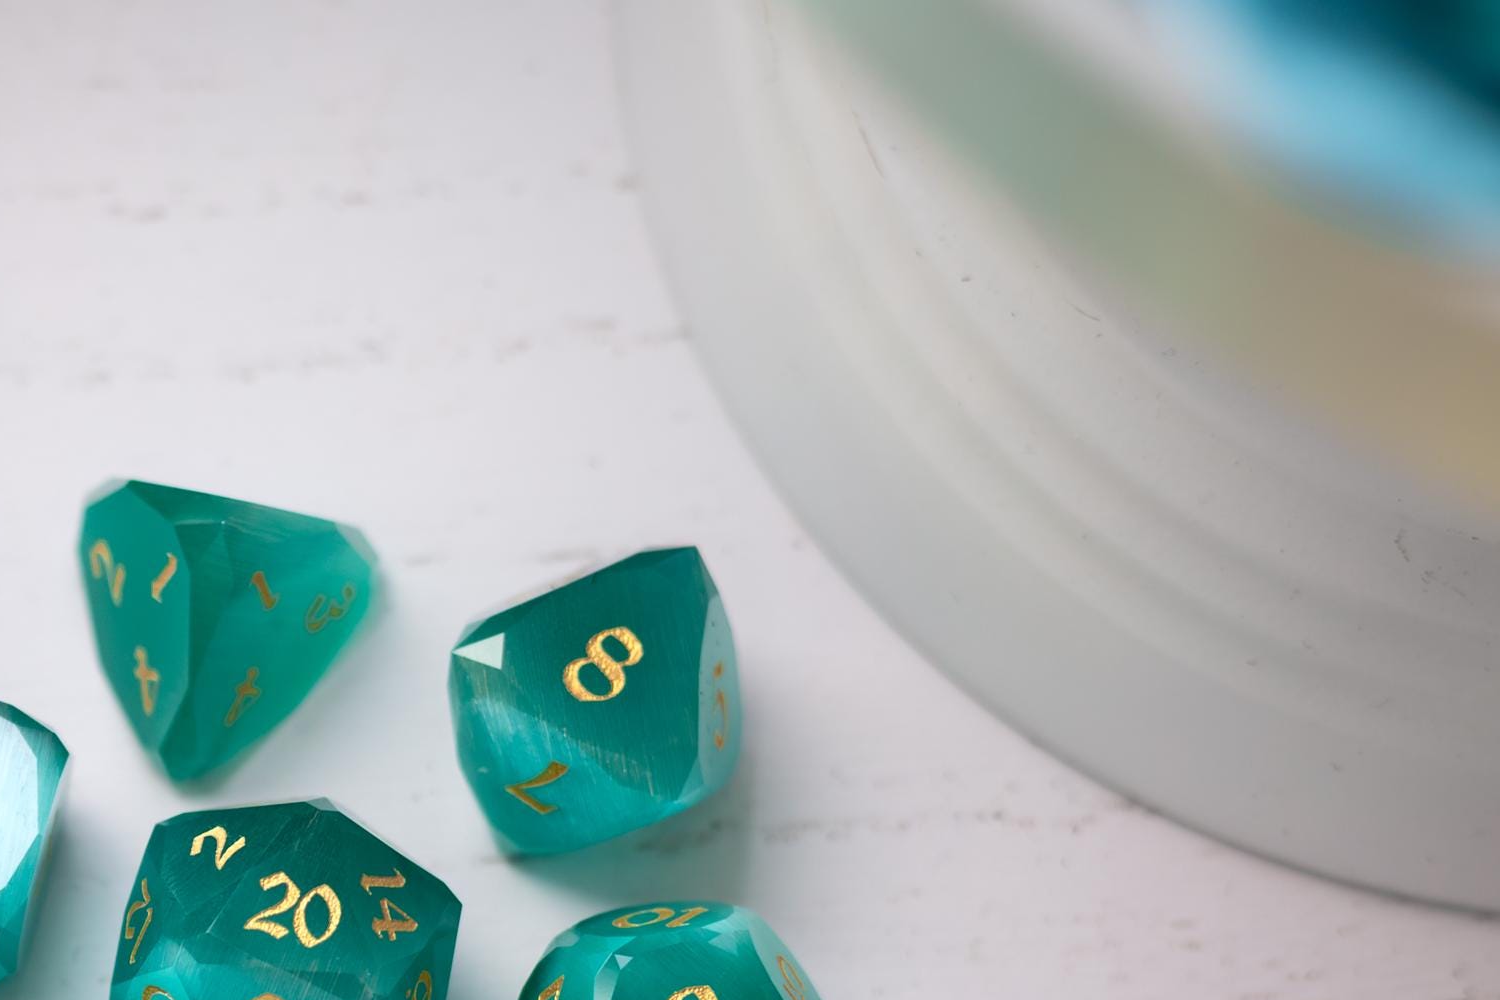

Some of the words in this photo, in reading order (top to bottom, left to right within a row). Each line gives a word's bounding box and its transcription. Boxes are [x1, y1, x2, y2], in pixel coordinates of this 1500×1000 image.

[563, 626, 644, 702] 8
[504, 760, 568, 814] 7
[190, 826, 246, 870] 2
[243, 871, 342, 948] 20
[360, 868, 418, 941] 14
[612, 907, 708, 928] 10
